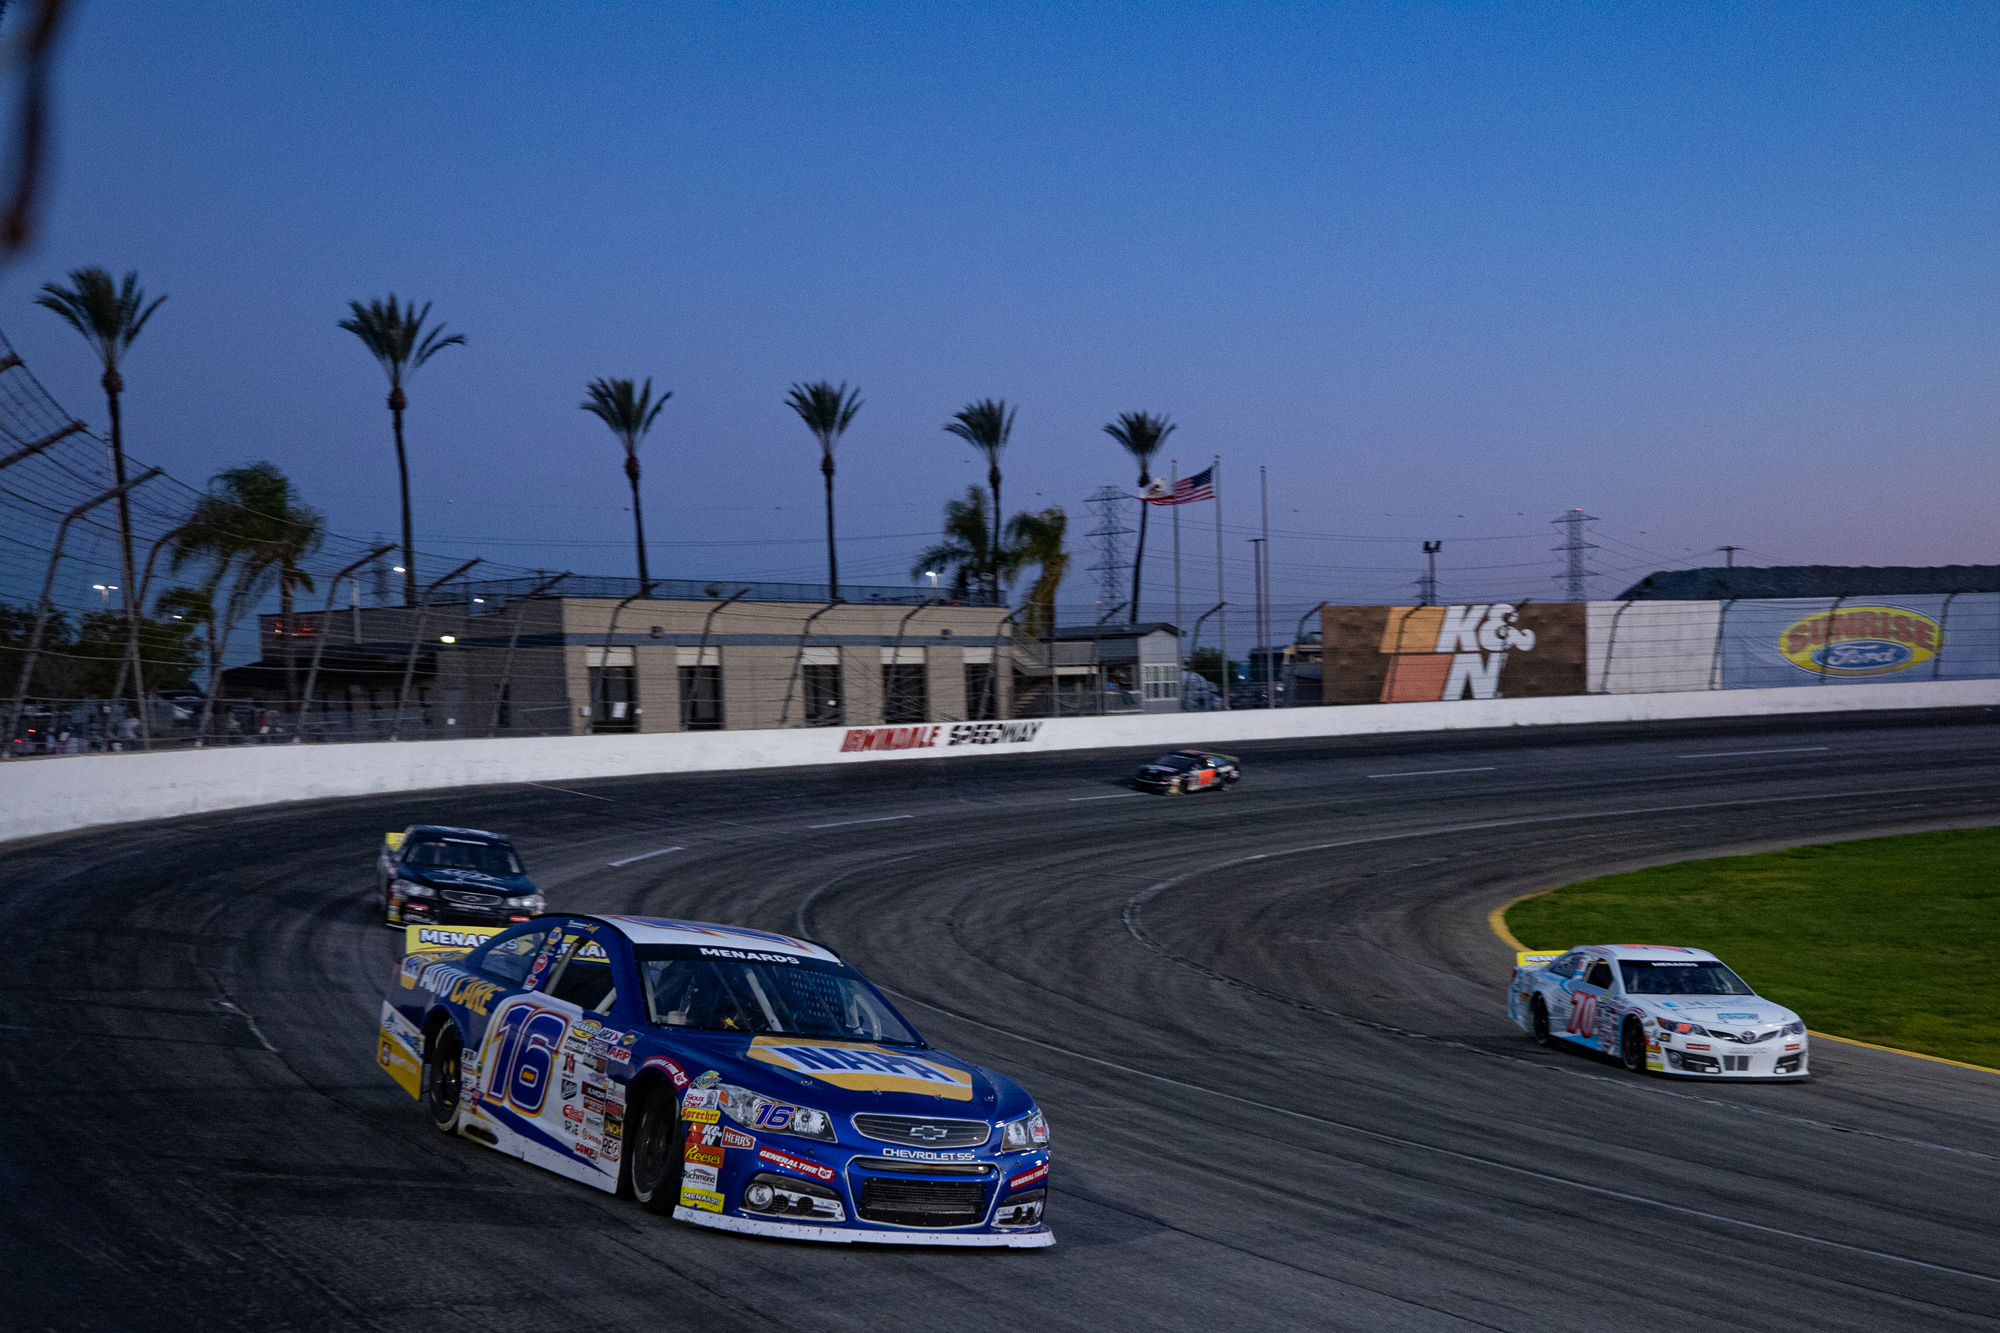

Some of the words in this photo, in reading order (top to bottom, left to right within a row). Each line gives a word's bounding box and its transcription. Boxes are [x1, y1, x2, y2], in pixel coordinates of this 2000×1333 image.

[1787, 611, 1935, 655] SUNRISE
[1826, 645, 1899, 666] Ford
[699, 947, 801, 965] MENARDS
[450, 976, 507, 1016] CARE
[1567, 990, 1597, 1038] 70
[483, 1002, 572, 1118] 16
[608, 1047, 631, 1061] ARP
[770, 1046, 956, 1083] NAPA
[685, 1093, 705, 1102] Sioux
[682, 1108, 719, 1122] Sprecher
[752, 1102, 797, 1129] 16
[725, 1132, 752, 1147] HERR'S
[576, 1142, 595, 1156] COMP
[685, 1145, 721, 1165] Reese's
[882, 1148, 956, 1161] CHEVROLET
[957, 1152, 973, 1161] SS
[759, 1150, 798, 1168] GENERAL
[798, 1162, 818, 1174] TIRE
[682, 1171, 716, 1183] Richmond
[1010, 1173, 1034, 1188] GENERAL
[683, 1192, 720, 1205] MENARDS
